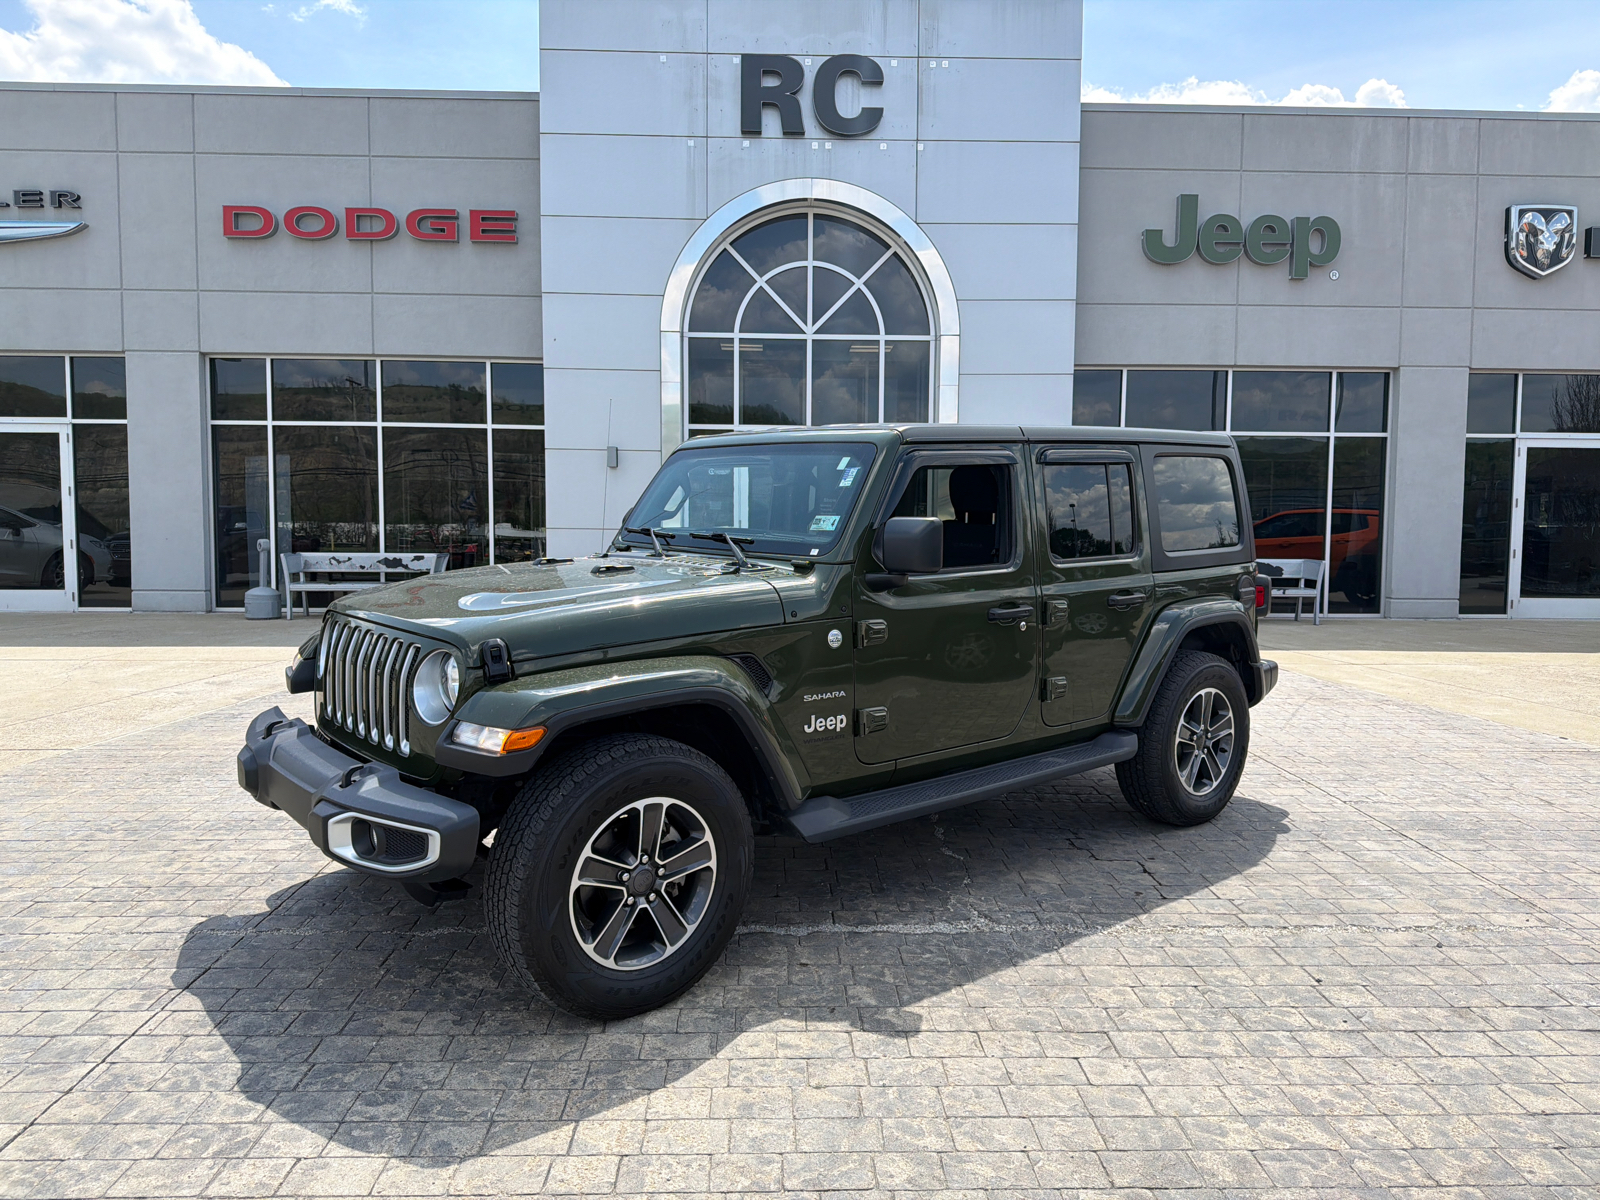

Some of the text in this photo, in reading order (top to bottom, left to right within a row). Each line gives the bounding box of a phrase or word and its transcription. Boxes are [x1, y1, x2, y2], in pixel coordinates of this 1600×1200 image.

[741, 53, 885, 137] RC
[222, 205, 518, 243] DODGE
[1142, 193, 1341, 280] Jeep
[803, 690, 846, 702] SAHARA
[804, 714, 847, 733] Jeep
